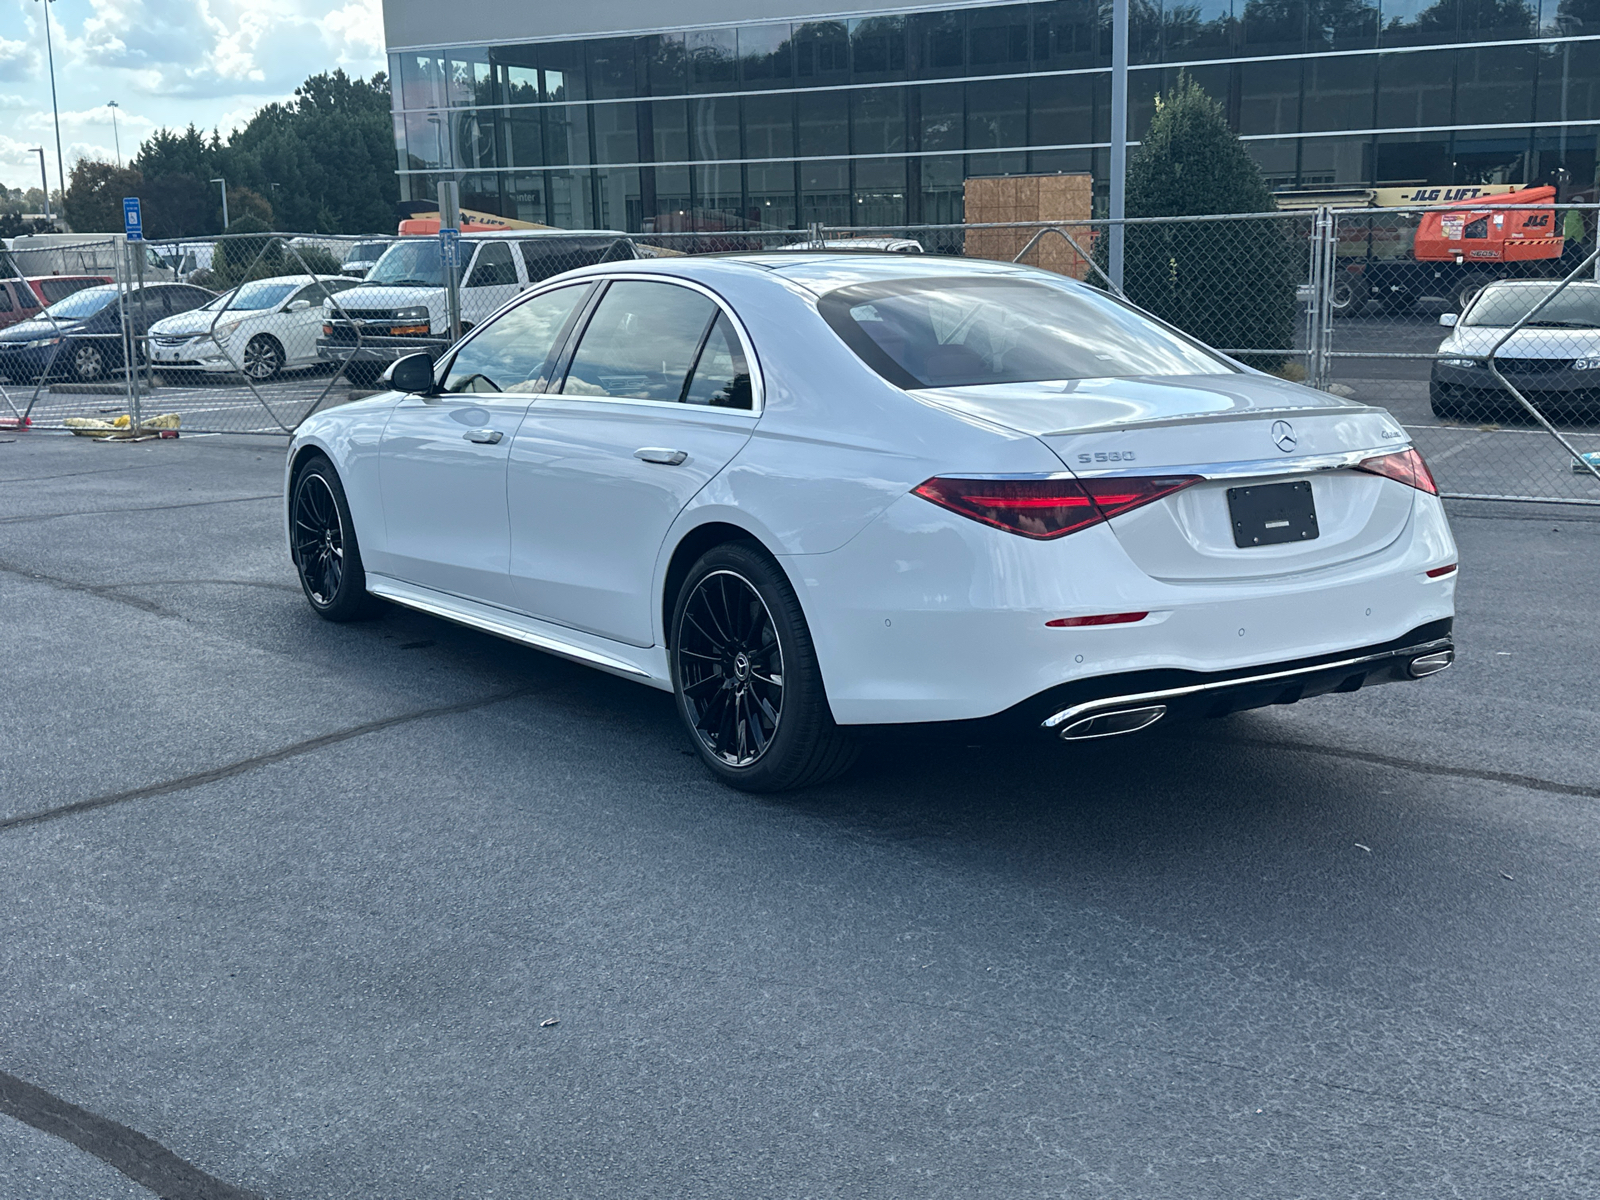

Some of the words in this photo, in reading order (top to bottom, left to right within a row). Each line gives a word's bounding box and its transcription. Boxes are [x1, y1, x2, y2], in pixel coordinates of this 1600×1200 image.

[1410, 189, 1441, 201] JLG
[1443, 188, 1481, 200] LIFT
[1522, 215, 1549, 227] JLG
